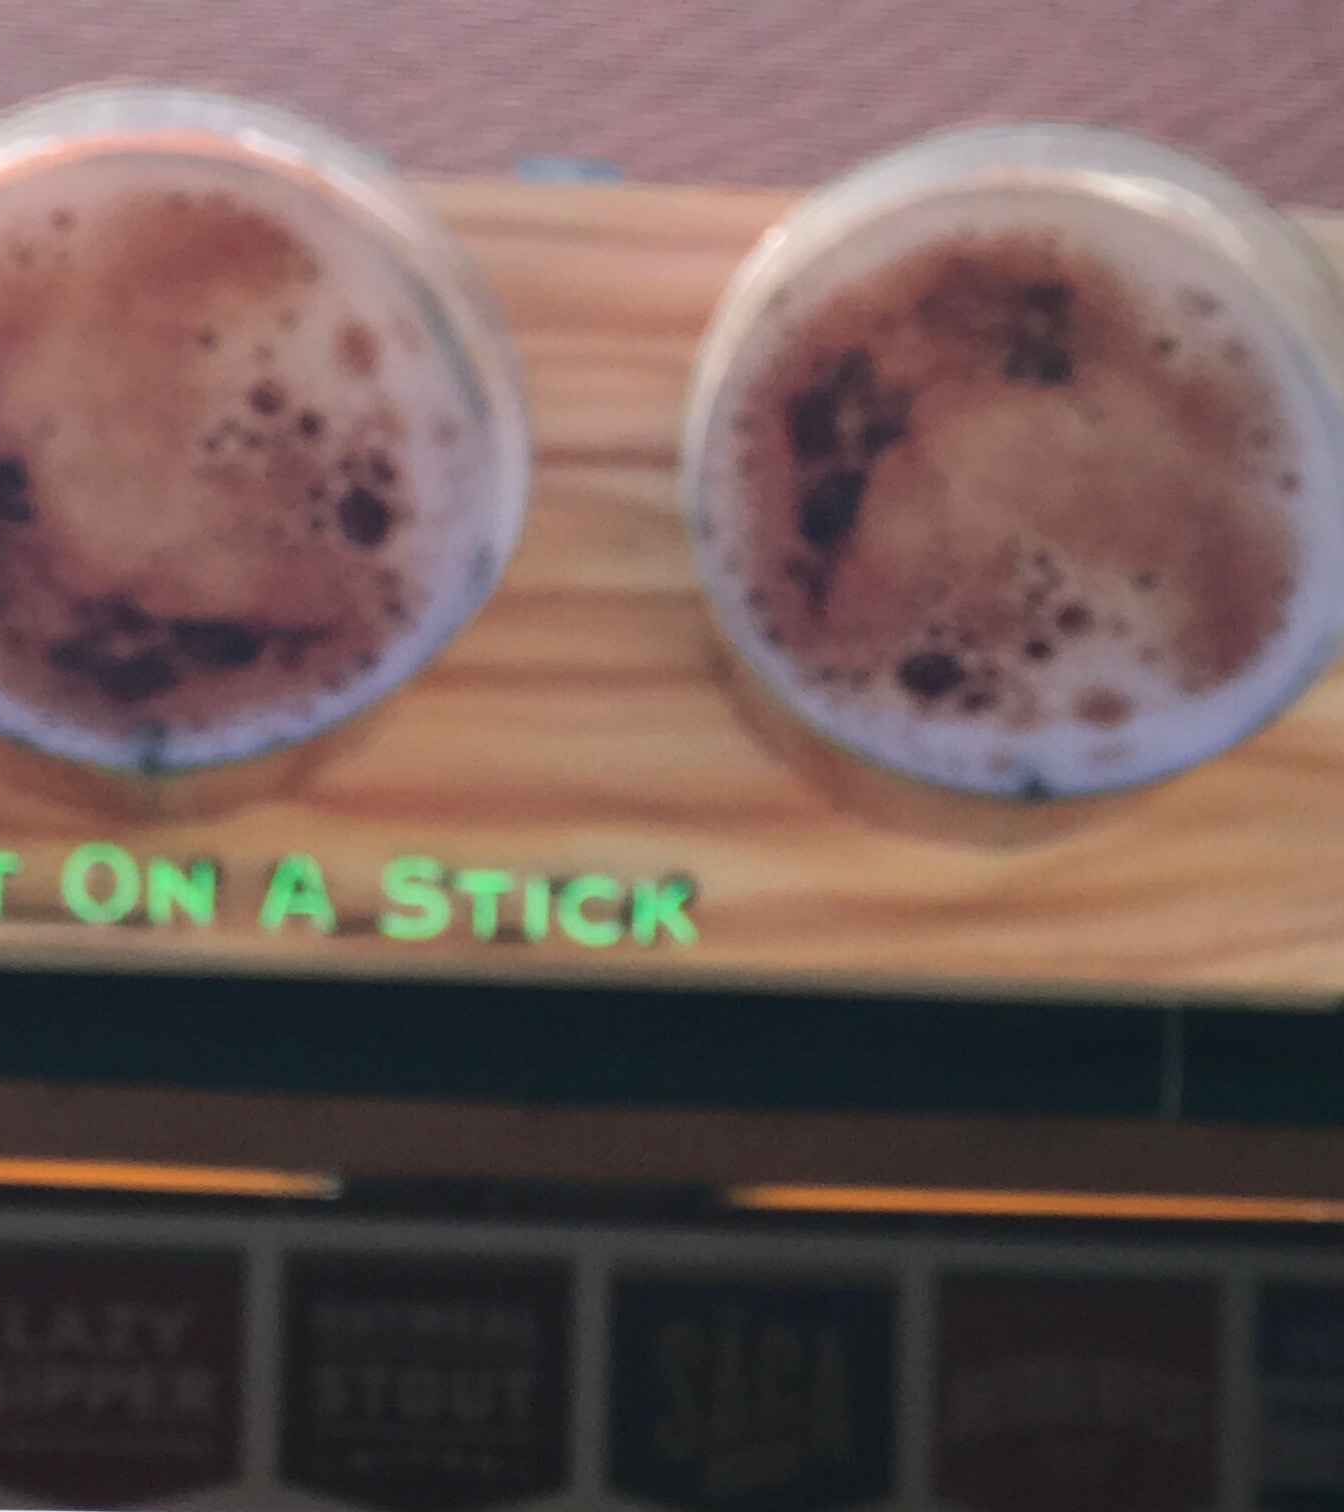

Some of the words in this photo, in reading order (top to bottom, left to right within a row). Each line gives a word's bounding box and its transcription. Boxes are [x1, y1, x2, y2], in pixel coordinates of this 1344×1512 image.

[58, 838, 220, 928] ON
[258, 850, 340, 936] A
[378, 852, 701, 948] STICK
